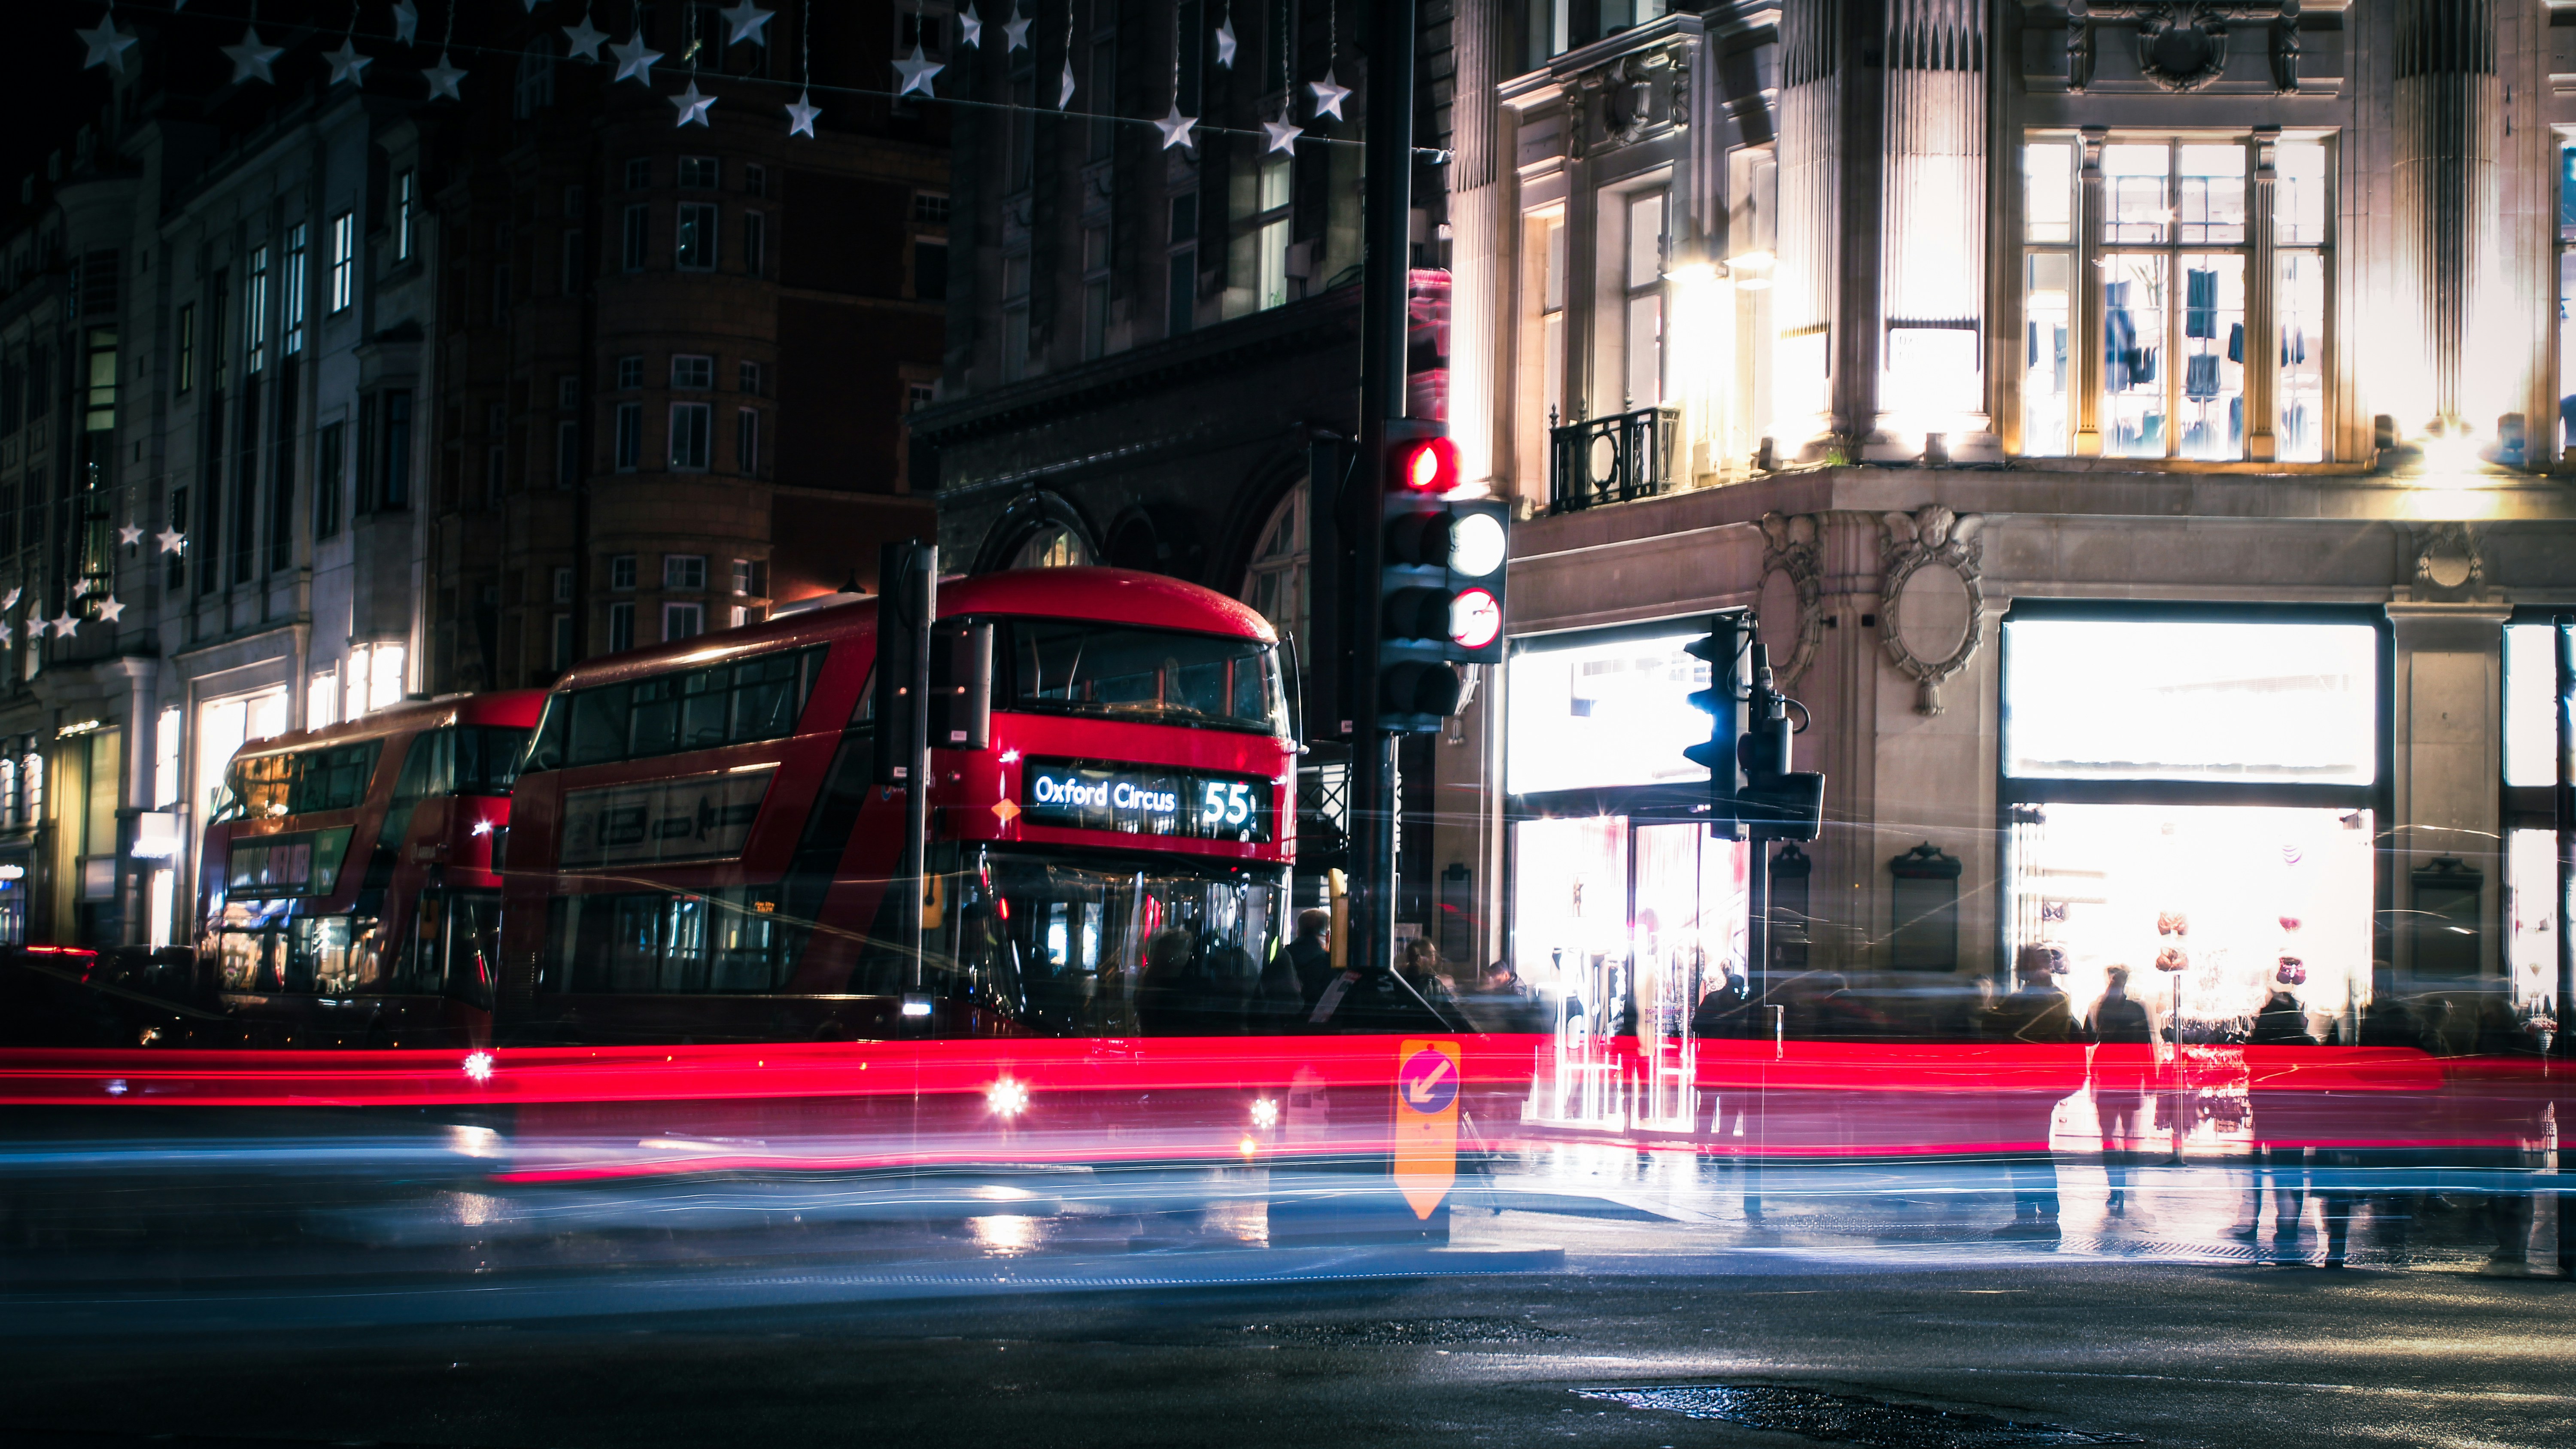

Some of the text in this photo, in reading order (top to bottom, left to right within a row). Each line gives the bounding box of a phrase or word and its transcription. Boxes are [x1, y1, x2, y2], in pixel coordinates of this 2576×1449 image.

[1035, 775, 1176, 812] Oxford Circus
[1203, 782, 1249, 824] 55
